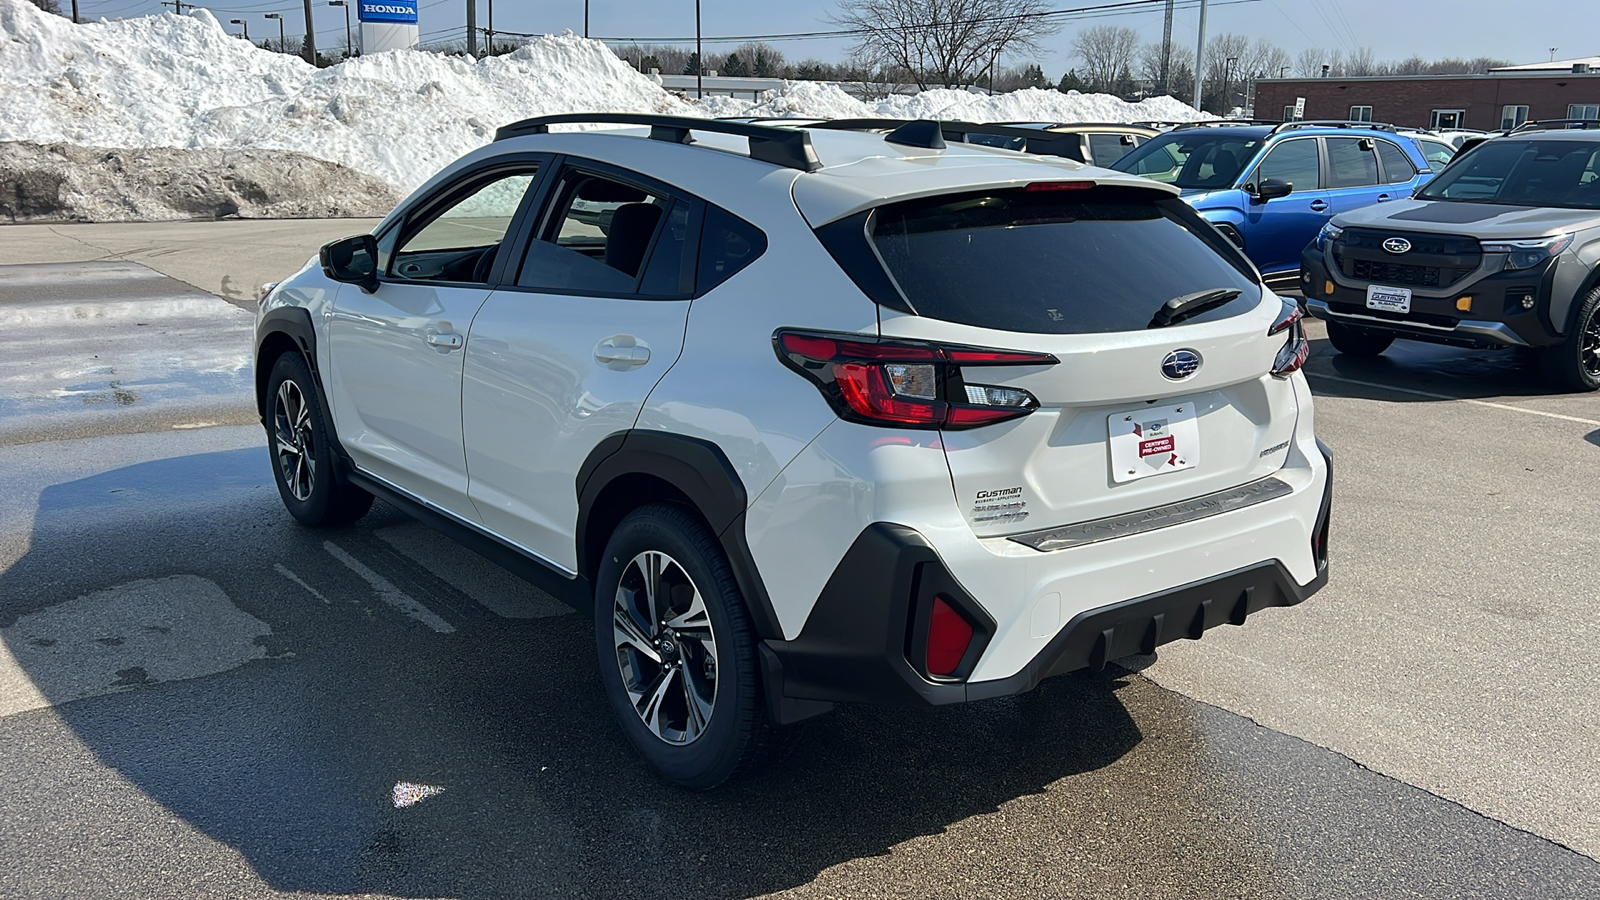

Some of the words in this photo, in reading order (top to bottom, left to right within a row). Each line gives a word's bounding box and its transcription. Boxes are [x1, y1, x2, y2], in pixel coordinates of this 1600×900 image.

[363, 4, 416, 14] HONDA
[1144, 439, 1170, 448] CERTIFIED
[1142, 445, 1172, 454] PRE-OWNED
